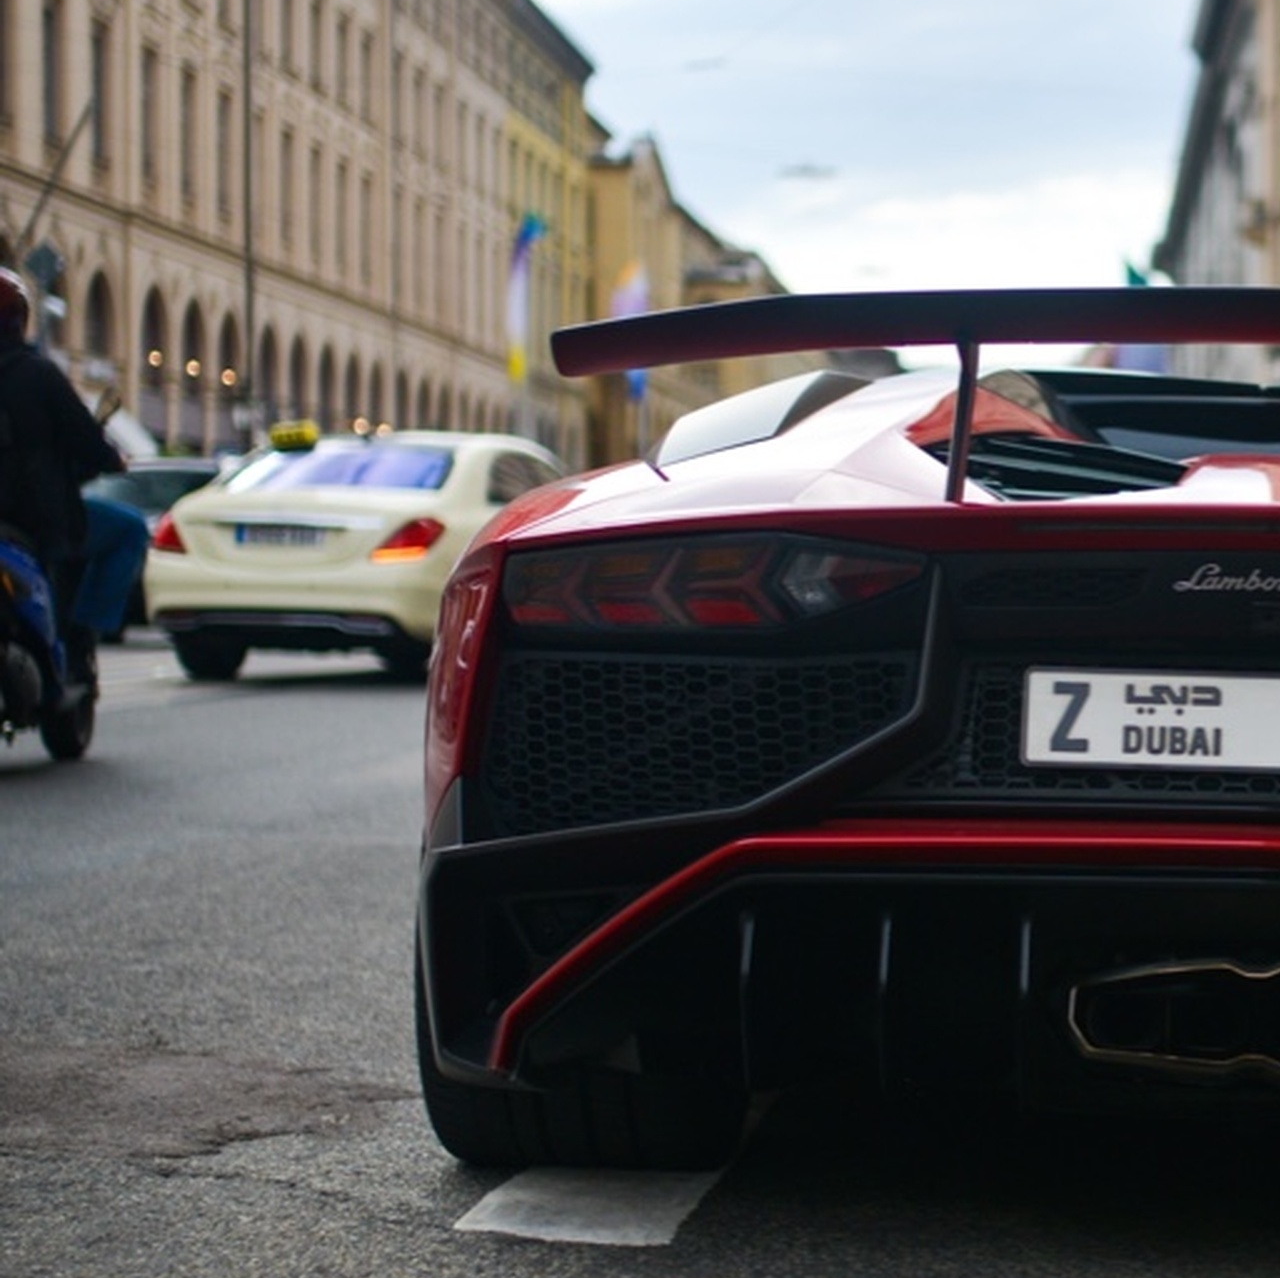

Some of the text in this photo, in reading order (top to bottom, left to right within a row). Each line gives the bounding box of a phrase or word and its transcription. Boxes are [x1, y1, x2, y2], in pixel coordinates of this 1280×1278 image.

[1124, 683, 1222, 716] دبي
[1049, 681, 1091, 753] Z
[1122, 724, 1222, 757] DUBAI
